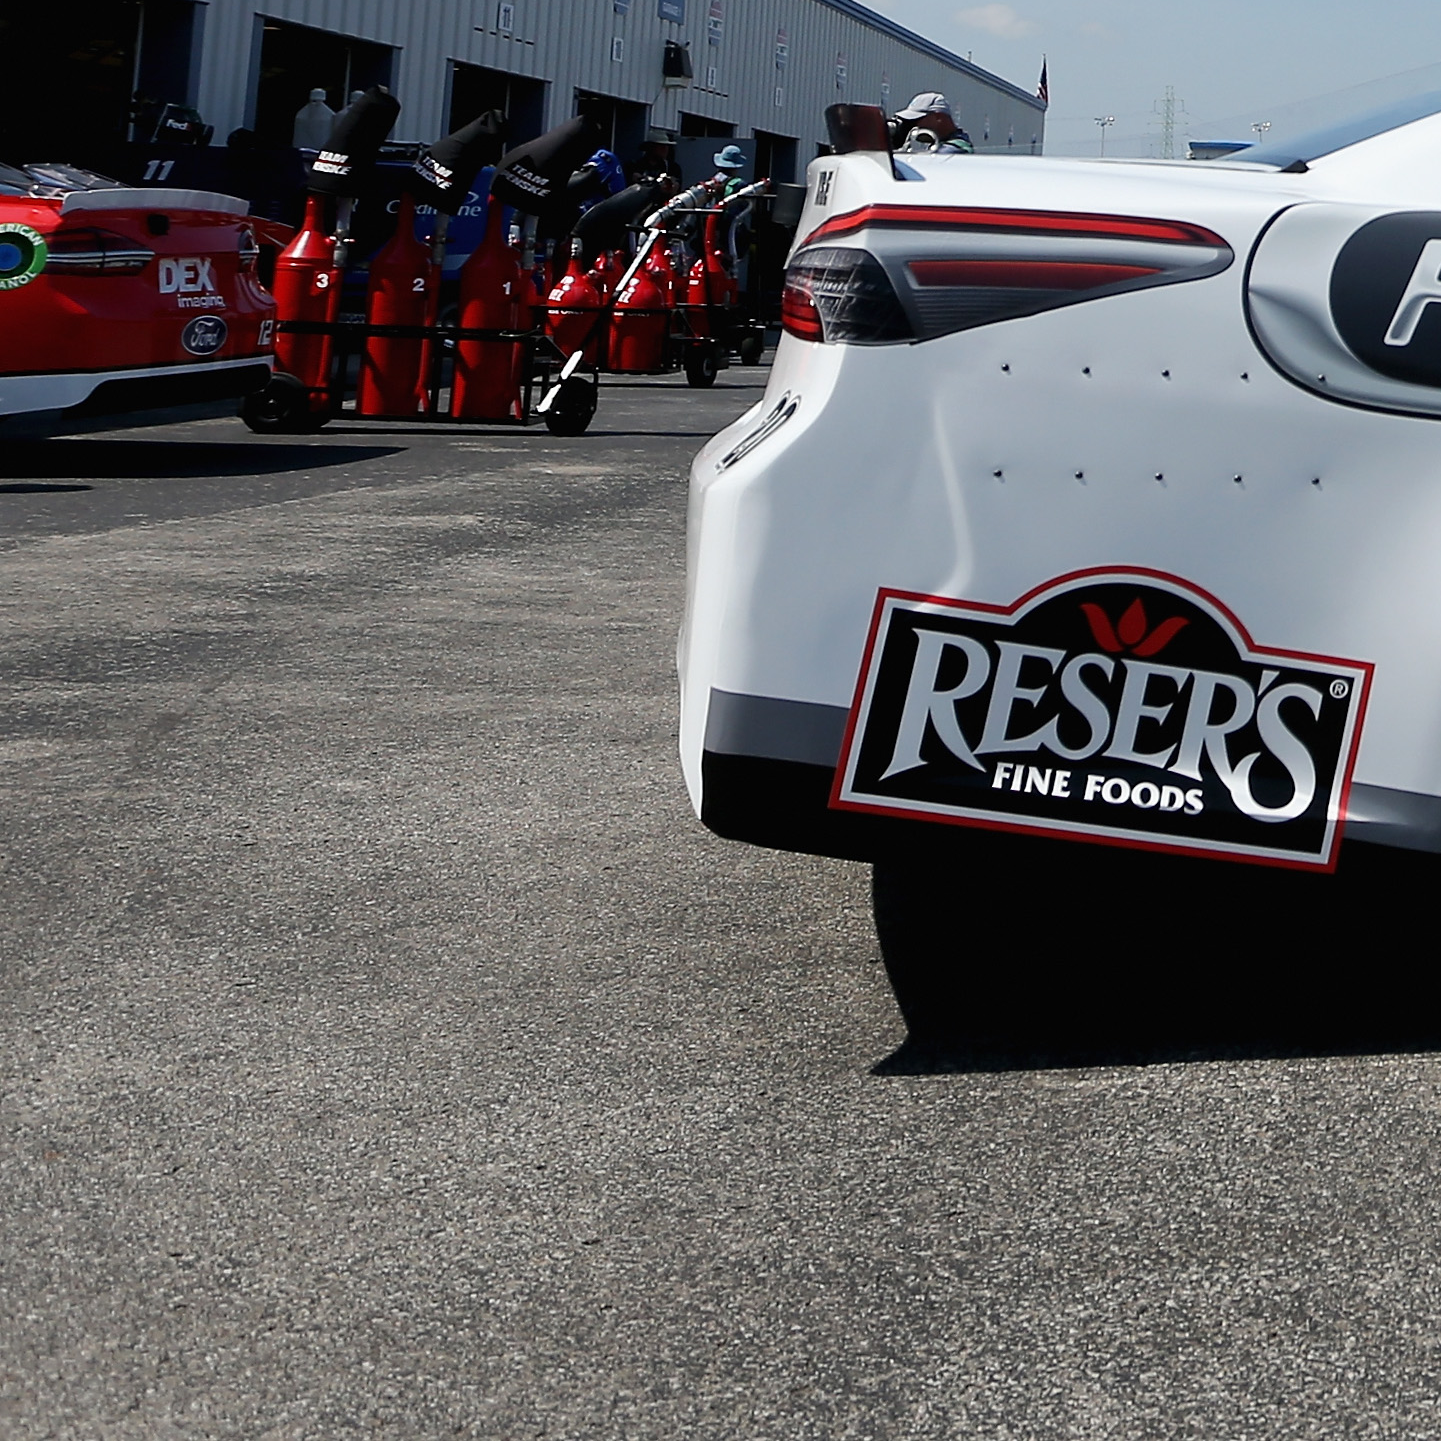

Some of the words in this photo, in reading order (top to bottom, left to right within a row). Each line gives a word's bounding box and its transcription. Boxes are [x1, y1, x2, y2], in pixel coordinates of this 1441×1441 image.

[143, 160, 176, 180] 11
[512, 164, 550, 185] TEAM
[0, 223, 44, 246] ERICAN
[0, 271, 37, 289] ANOL
[158, 257, 215, 294] DEX
[316, 274, 329, 288] 3
[412, 277, 425, 292] 2
[503, 281, 512, 295] 1
[177, 294, 225, 309] imaging
[190, 321, 220, 348] Ford
[257, 320, 274, 346] 12
[879, 628, 1325, 822] RESER'S
[991, 761, 1072, 799] FINE
[1083, 773, 1205, 816] FOODS
